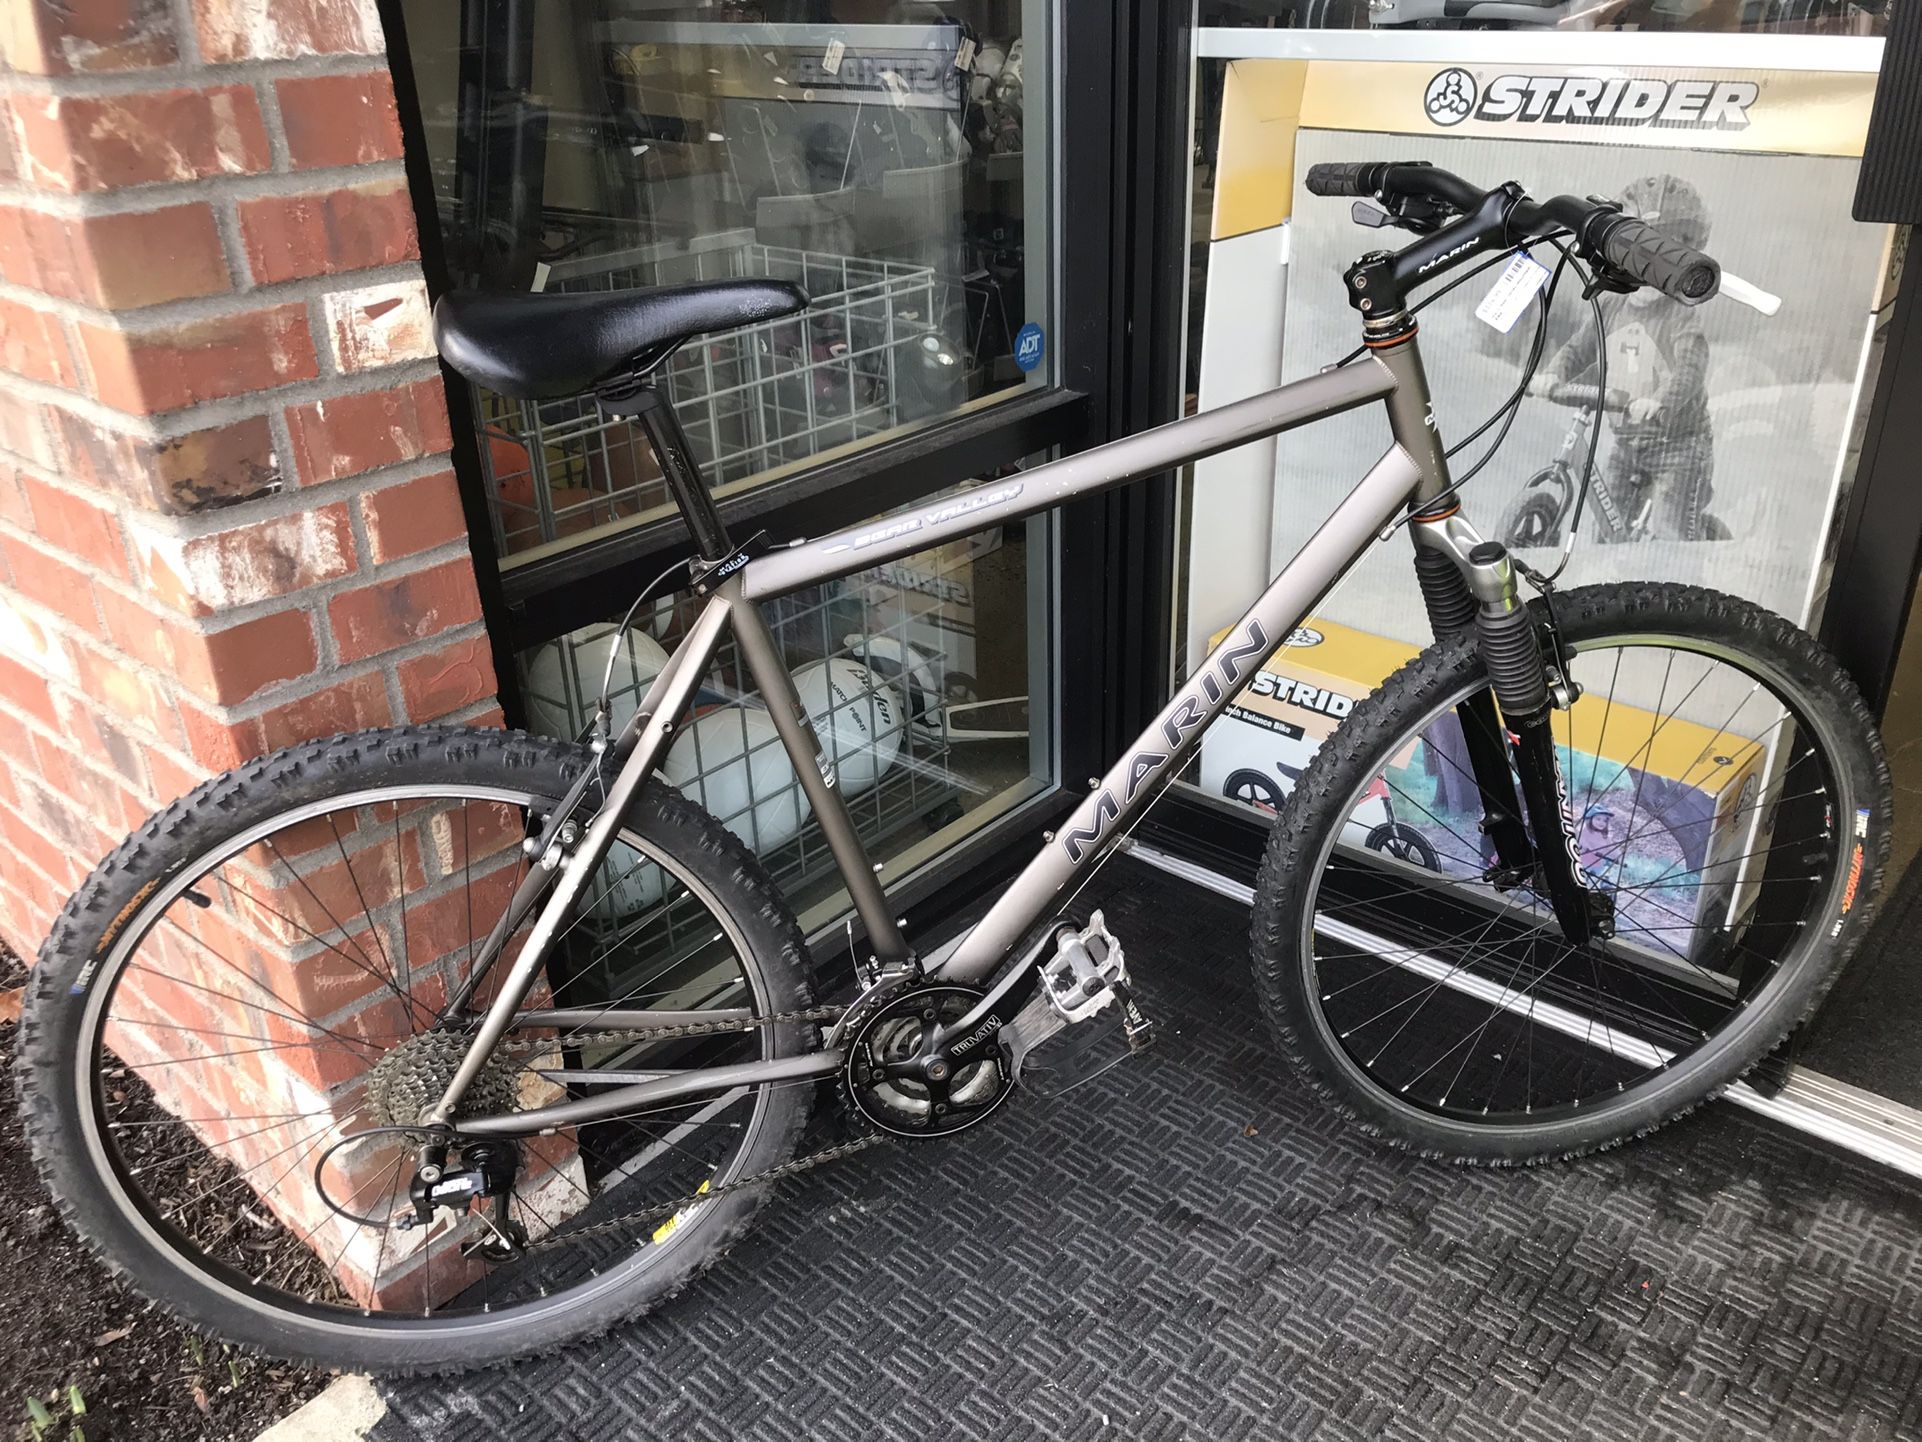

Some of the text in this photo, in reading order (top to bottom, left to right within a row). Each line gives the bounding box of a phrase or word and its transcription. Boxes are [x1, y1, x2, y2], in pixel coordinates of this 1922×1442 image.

[1473, 74, 1760, 131] STRIDER
[1417, 236, 1481, 274] MARIN
[1018, 333, 1041, 357] ADT
[1590, 466, 1622, 533] TRIDER
[1249, 670, 1358, 721] STRID
[1062, 618, 1269, 864] MARIN
[1242, 711, 1273, 729] Balance
[1273, 721, 1292, 734] Bike
[951, 1014, 1001, 1056] TRUVATIV
